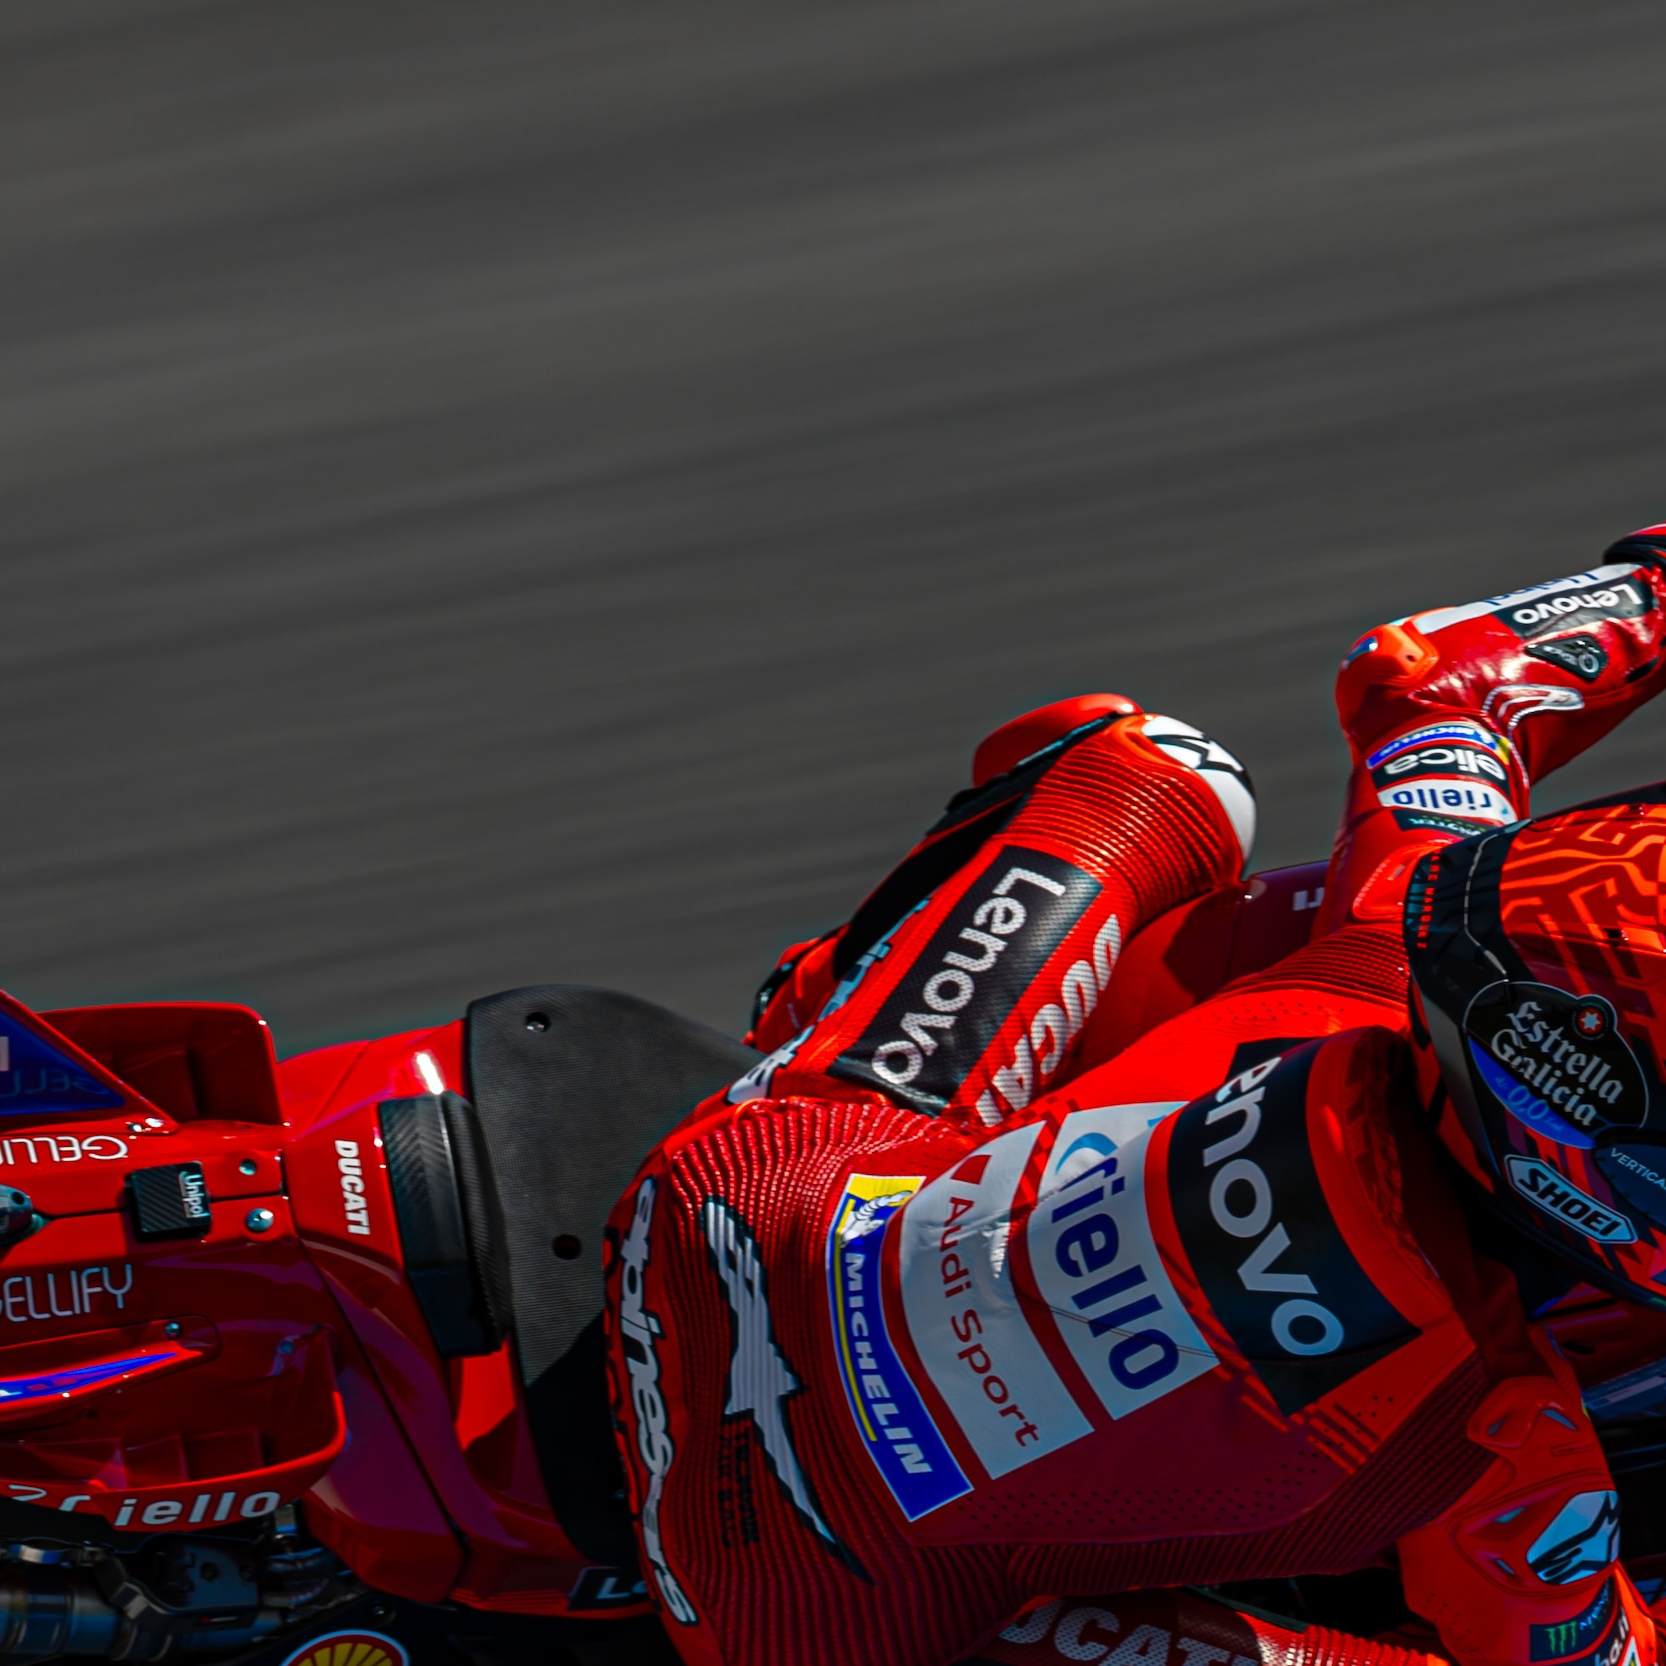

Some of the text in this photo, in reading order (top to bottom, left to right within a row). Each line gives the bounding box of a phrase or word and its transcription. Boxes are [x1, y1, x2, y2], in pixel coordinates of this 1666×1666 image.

[1512, 583, 1643, 624] Lenovo
[1385, 748, 1506, 781] elica
[1393, 788, 1491, 810] riello
[871, 867, 1065, 1085] Lenovo
[1491, 1028, 1597, 1126] Galicia
[1505, 1001, 1623, 1104] Estrella
[183, 1174, 210, 1218] Unipol
[335, 1140, 371, 1235] DUCATI
[1202, 1057, 1344, 1356] enovo
[1518, 1168, 1623, 1236] SHOEI
[937, 1196, 1041, 1448] Audi Sport
[1050, 1156, 1181, 1390] riello
[844, 1253, 933, 1475] MICHELIN
